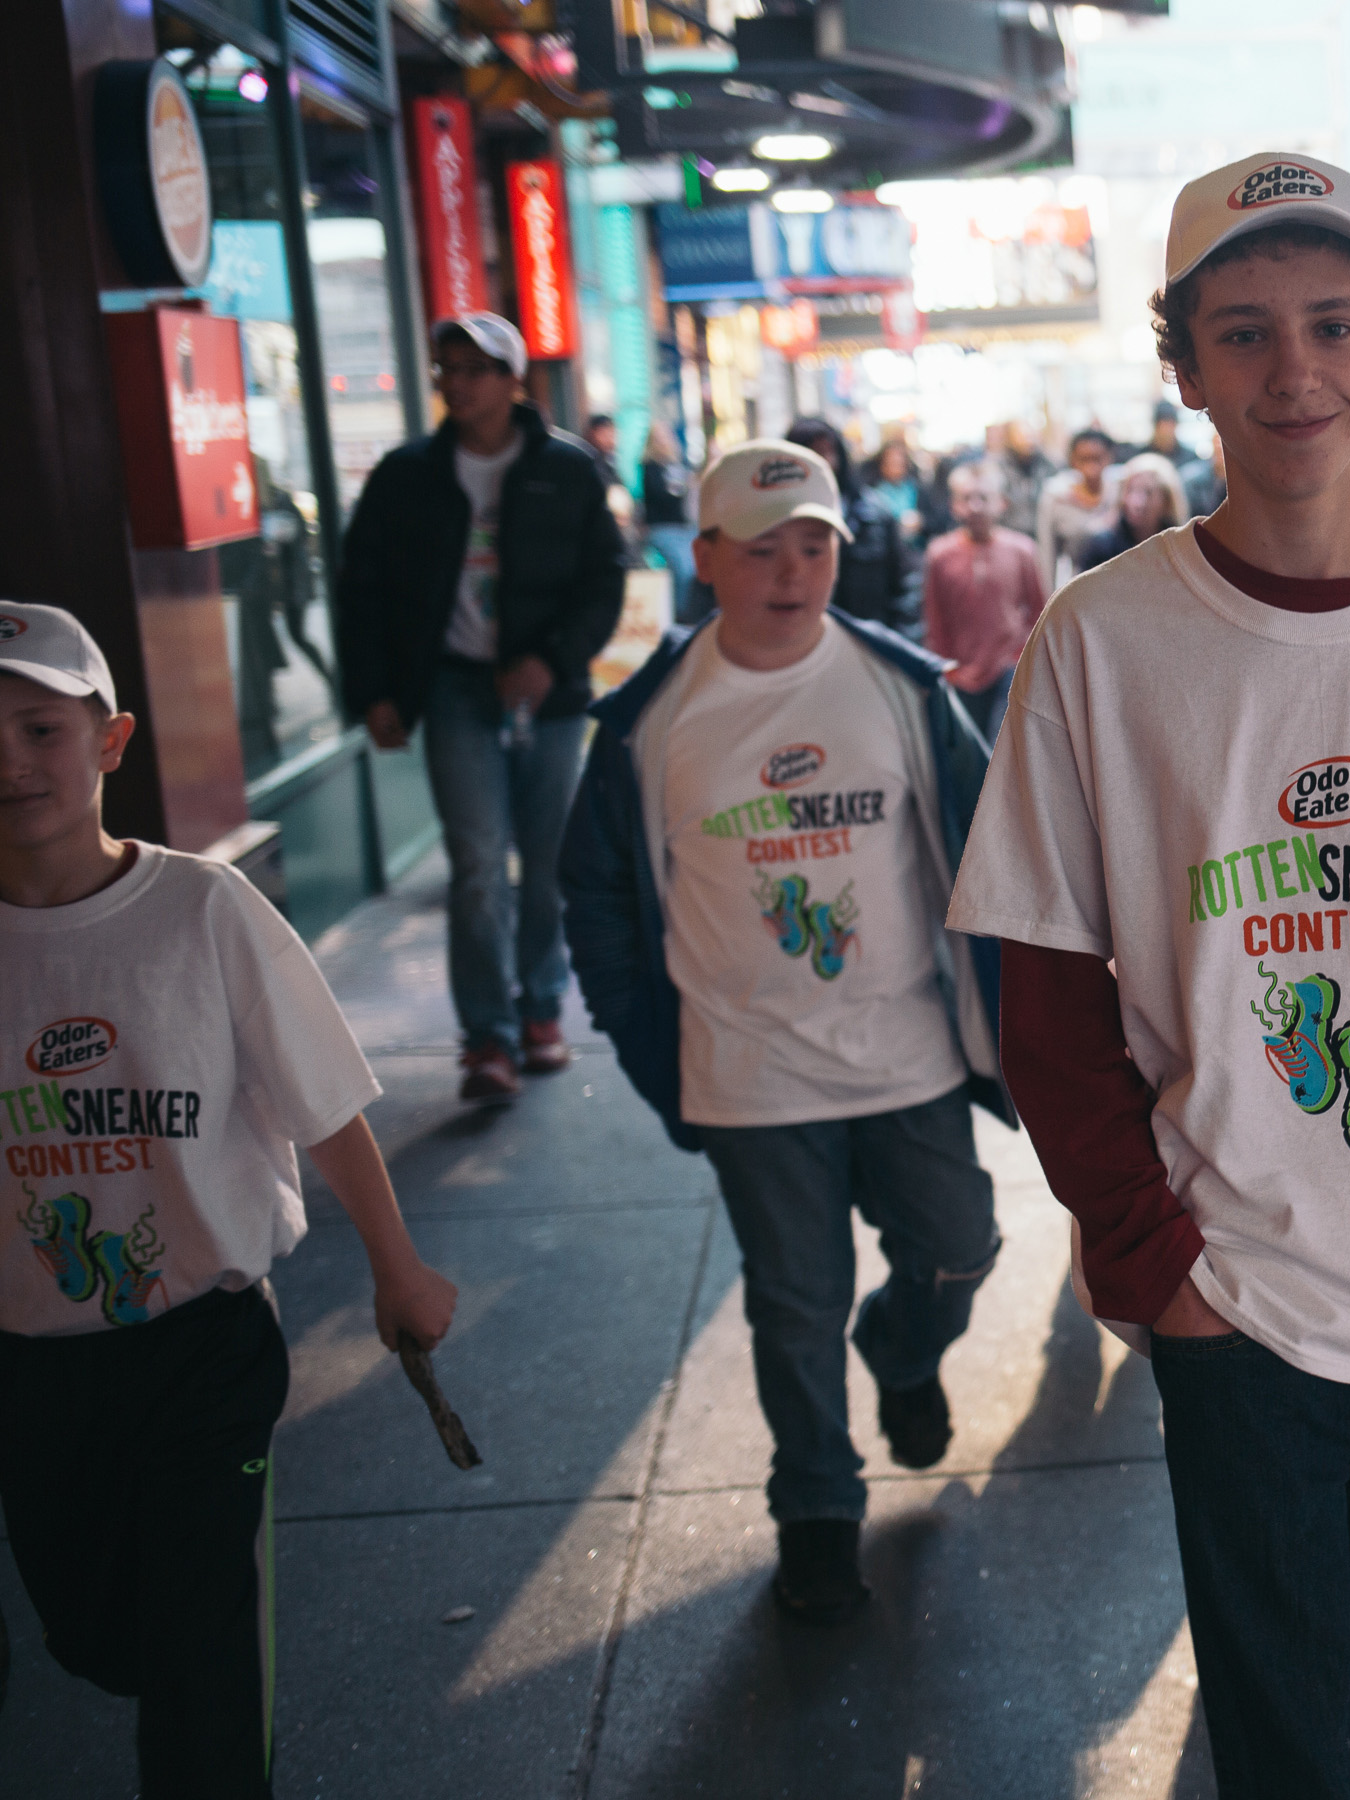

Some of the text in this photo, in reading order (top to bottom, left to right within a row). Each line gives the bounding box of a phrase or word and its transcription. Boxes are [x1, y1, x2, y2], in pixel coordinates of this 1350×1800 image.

[1241, 180, 1324, 209] Eaters
[1244, 165, 1315, 190] Odor-
[788, 789, 886, 830] SNEAKER
[747, 827, 853, 865] CONTEST
[1187, 833, 1325, 924] ROTTEN
[40, 1021, 100, 1051] Odor-
[38, 1038, 107, 1073] Eaters
[0, 1080, 200, 1139] TEN SNEAKER
[6, 1138, 153, 1178] CONTEST
